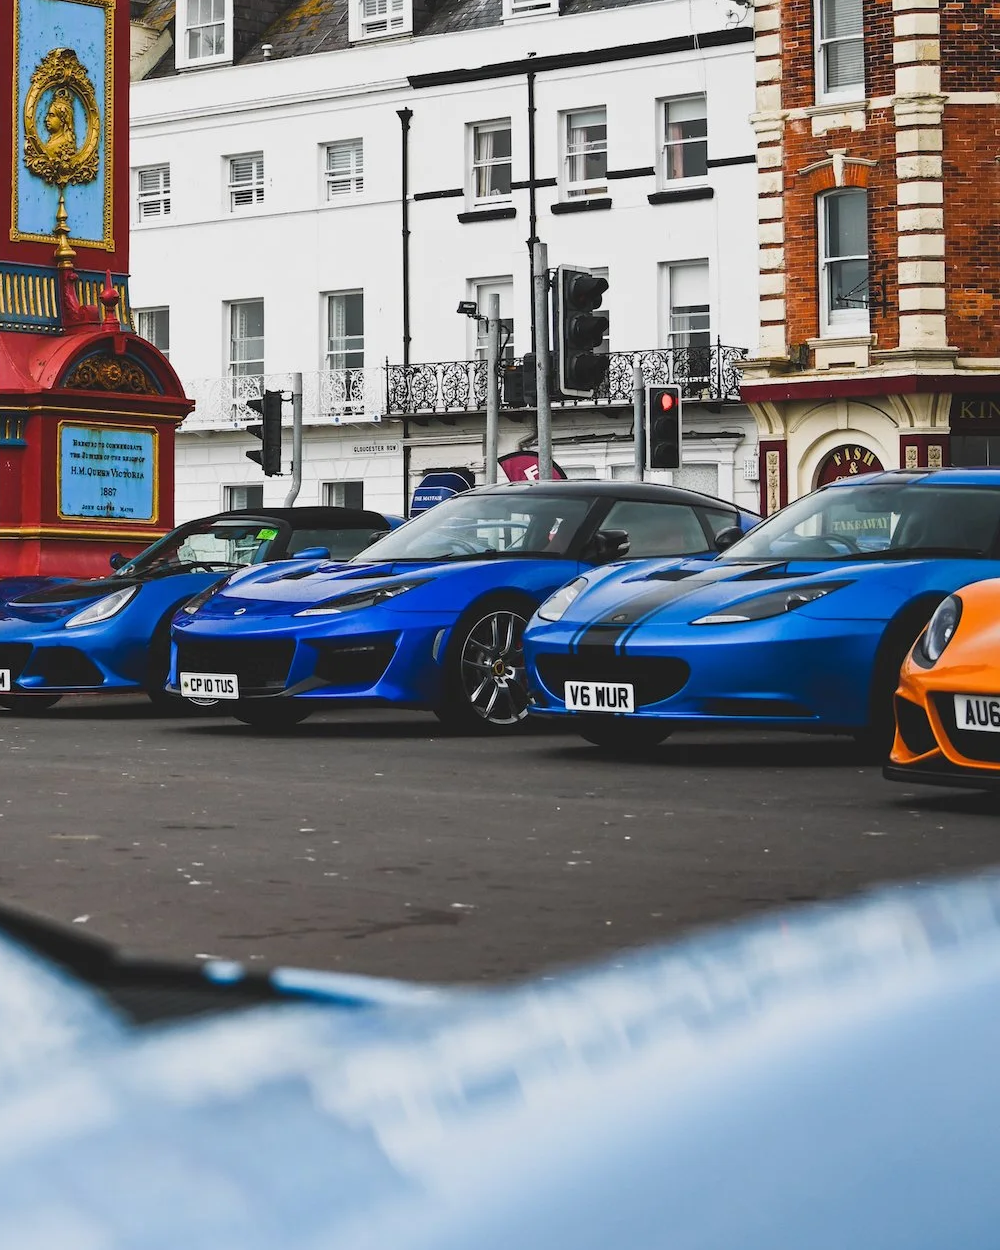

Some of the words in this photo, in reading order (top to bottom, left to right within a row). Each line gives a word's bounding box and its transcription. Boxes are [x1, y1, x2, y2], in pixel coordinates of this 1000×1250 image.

[833, 447, 875, 467] FISH
[111, 468, 144, 479] VICTORIA
[849, 461, 858, 474] &
[101, 487, 117, 496] 1887
[832, 517, 890, 531] TAKEAWAY
[214, 679, 234, 693] TUS
[570, 685, 590, 706] V6
[595, 686, 629, 708] WUR
[965, 699, 1000, 727] AU6
